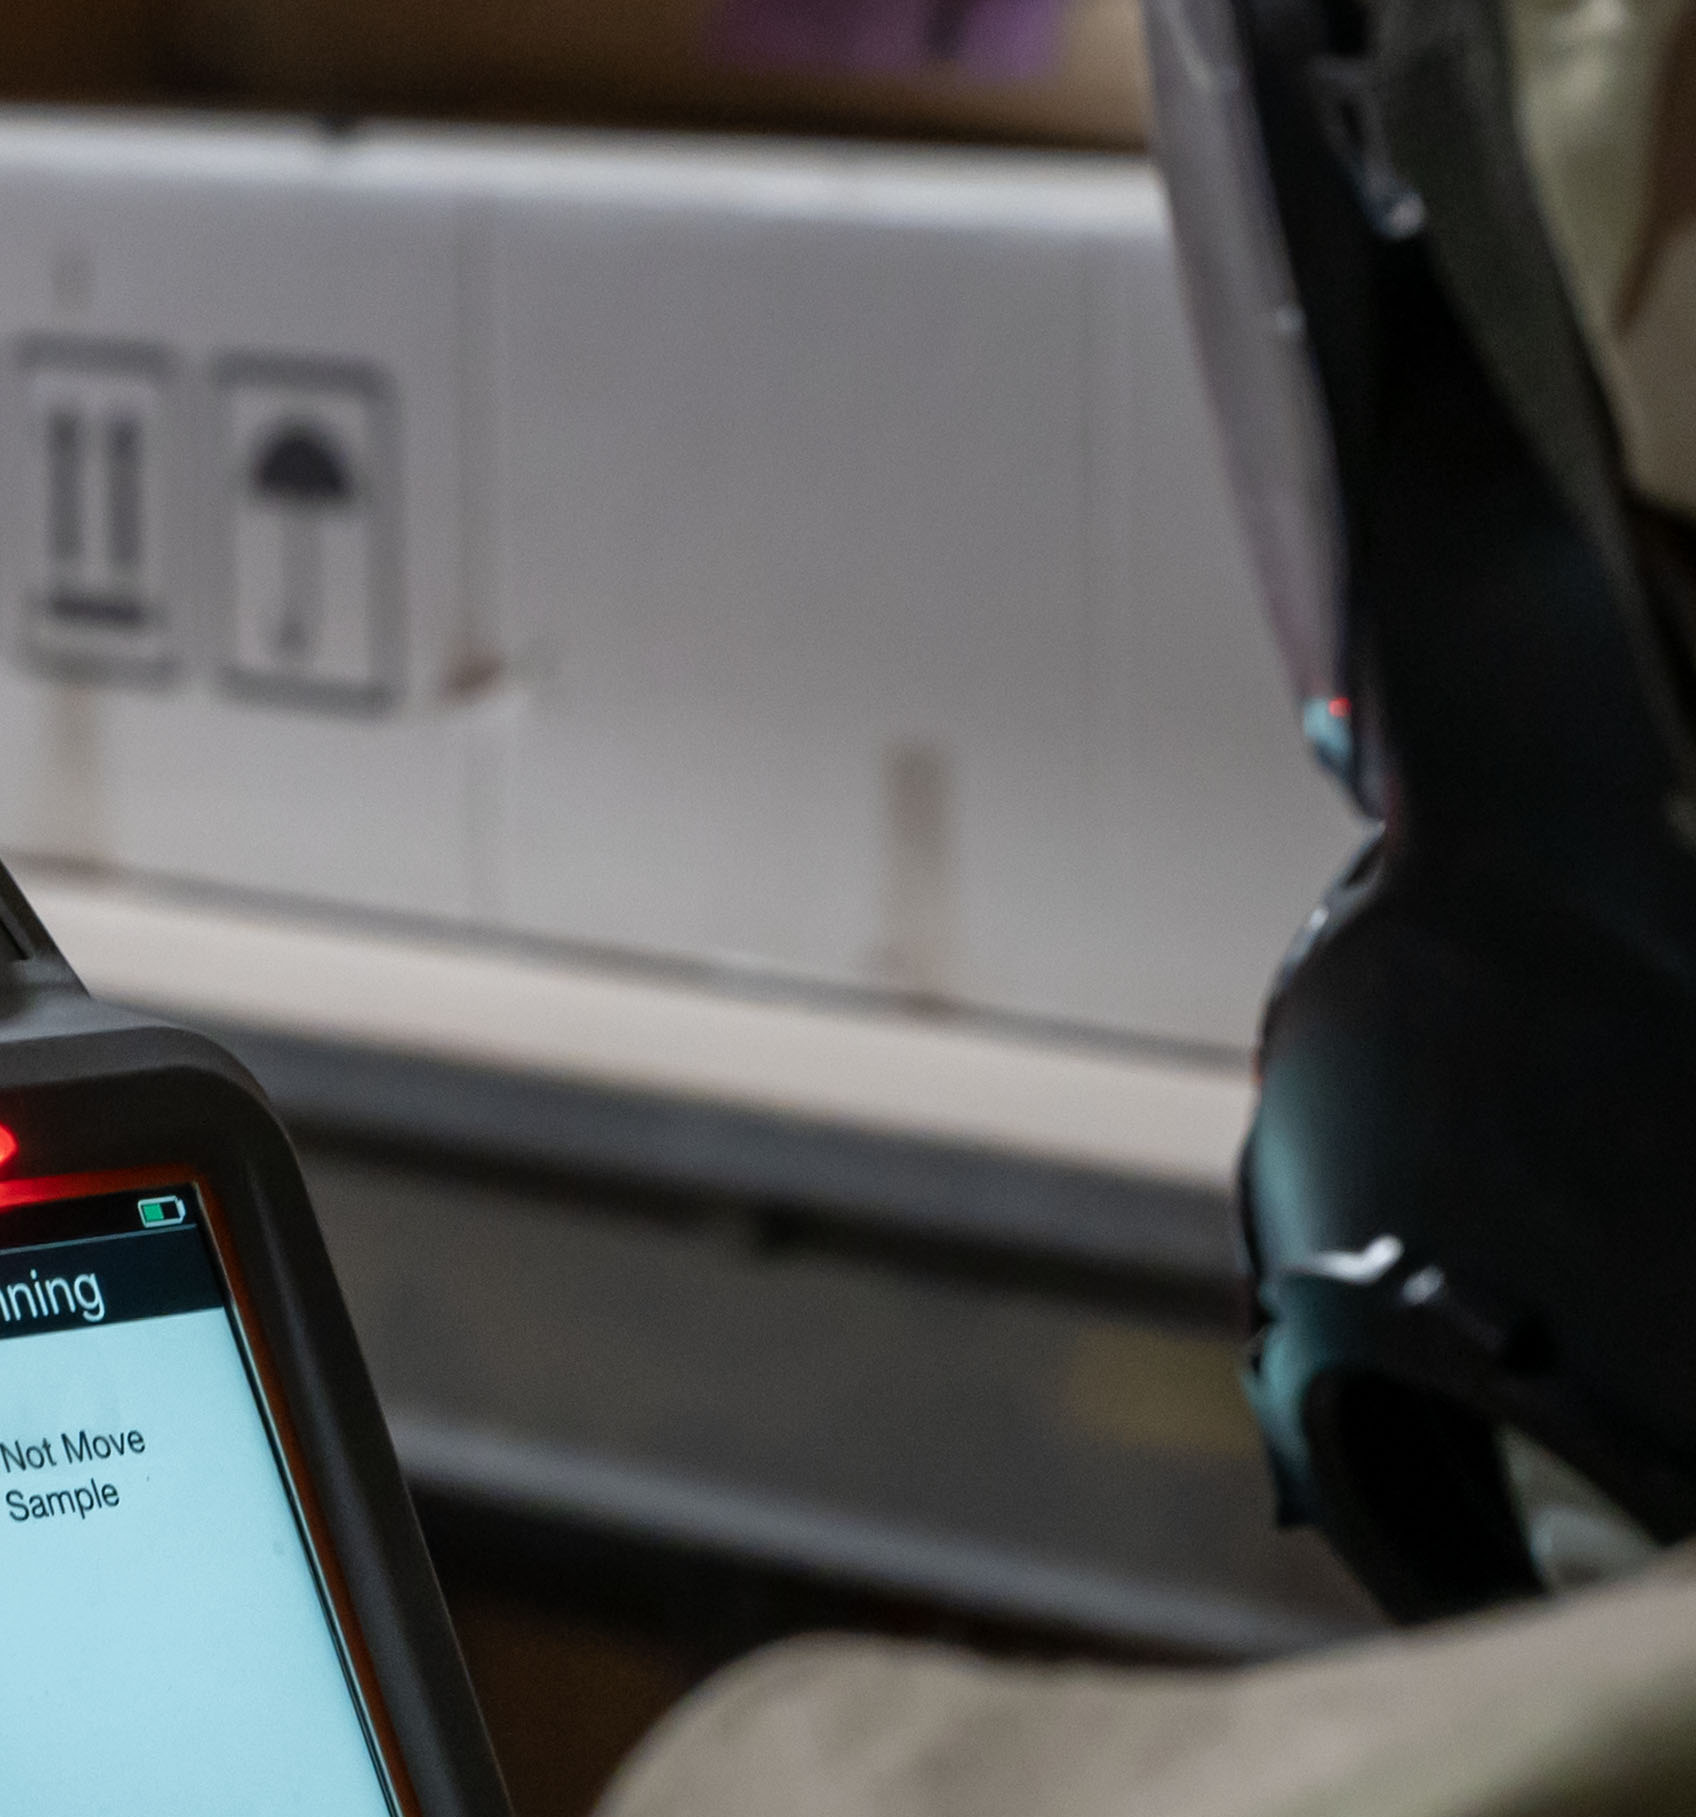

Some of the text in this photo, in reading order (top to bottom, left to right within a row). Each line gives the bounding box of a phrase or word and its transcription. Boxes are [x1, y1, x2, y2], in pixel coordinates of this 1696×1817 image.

[0, 1438, 58, 1474] Not
[61, 1427, 147, 1466] Move
[4, 1478, 120, 1523] Sample
